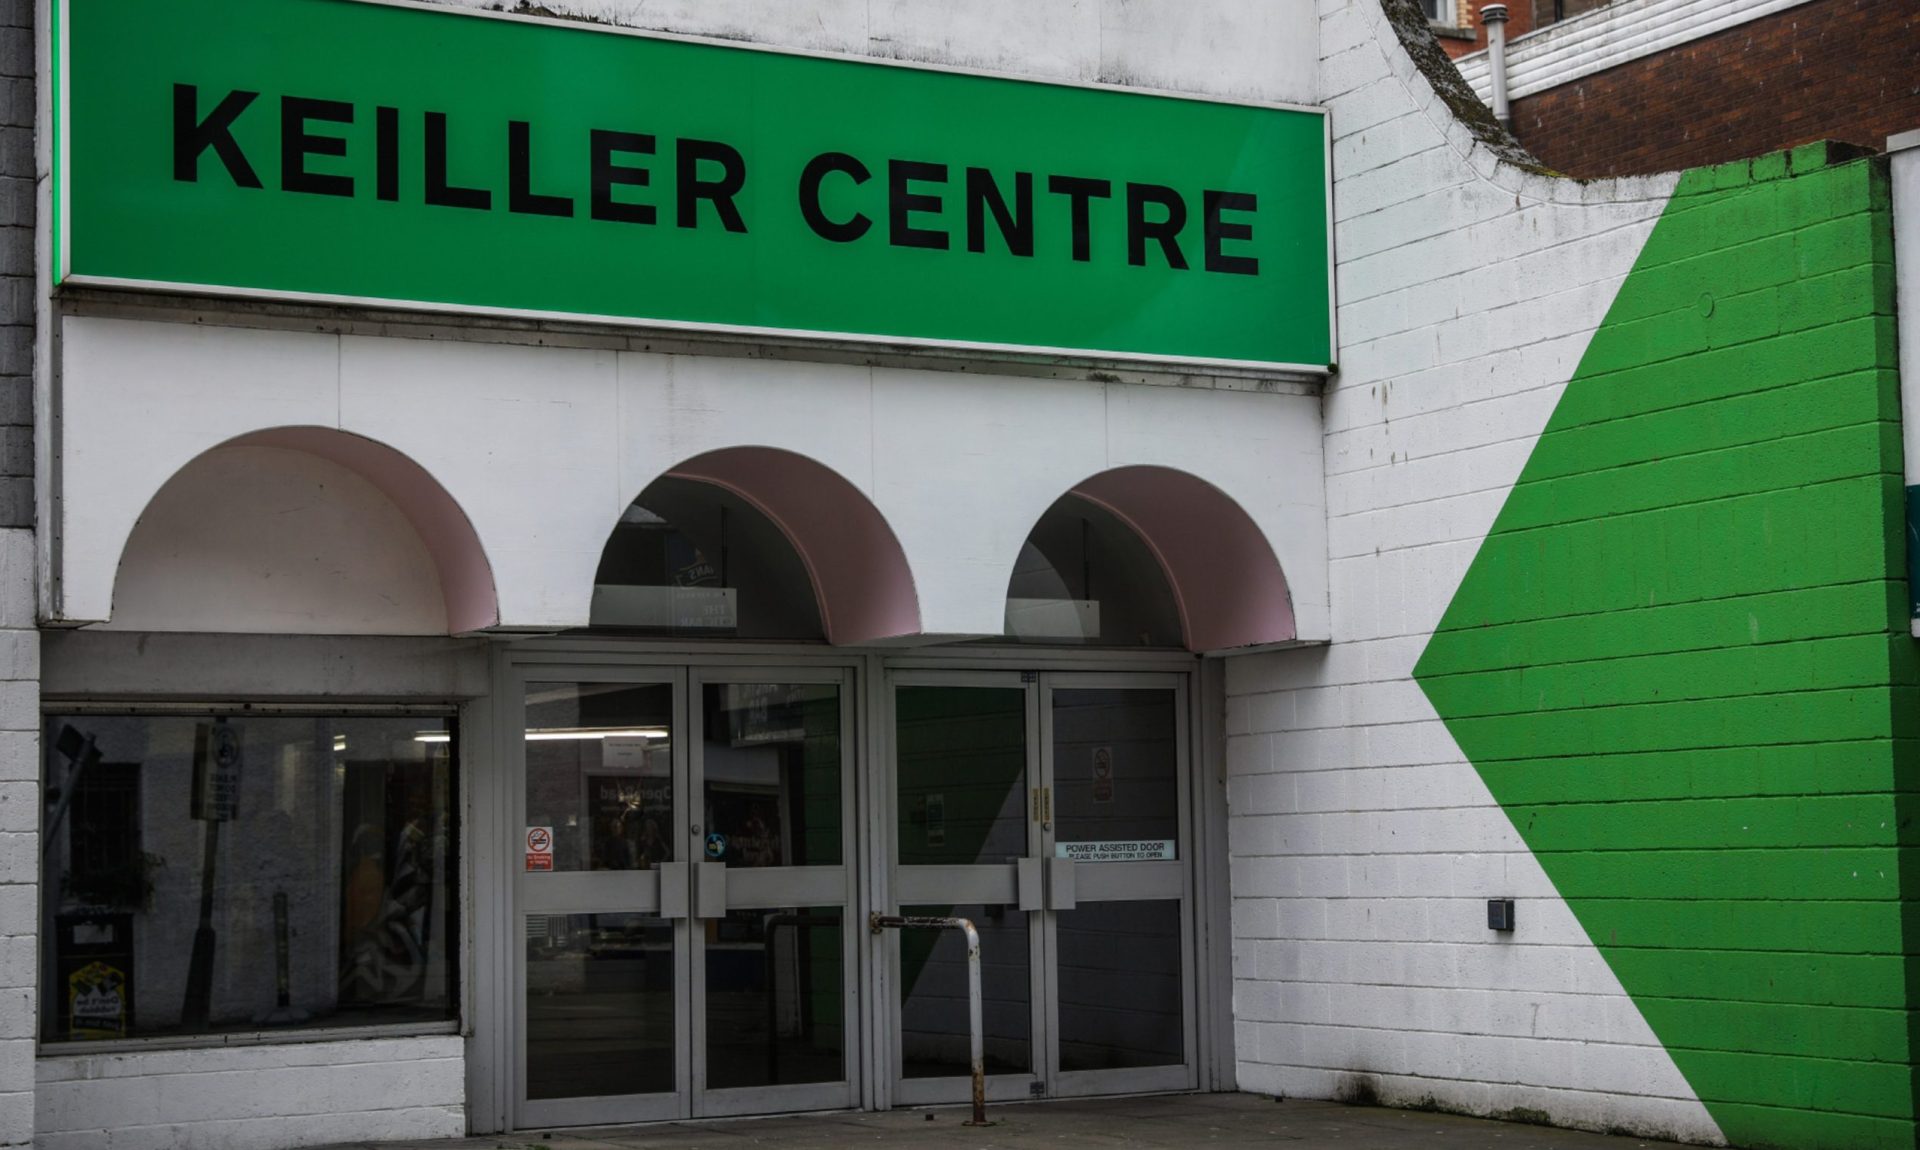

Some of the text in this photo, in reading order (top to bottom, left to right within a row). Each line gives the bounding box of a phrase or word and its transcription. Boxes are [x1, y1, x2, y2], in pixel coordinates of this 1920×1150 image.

[172, 82, 1260, 276] KEILLER CENTRE
[1066, 842, 1165, 853] POWER ASSISTED DOOR
